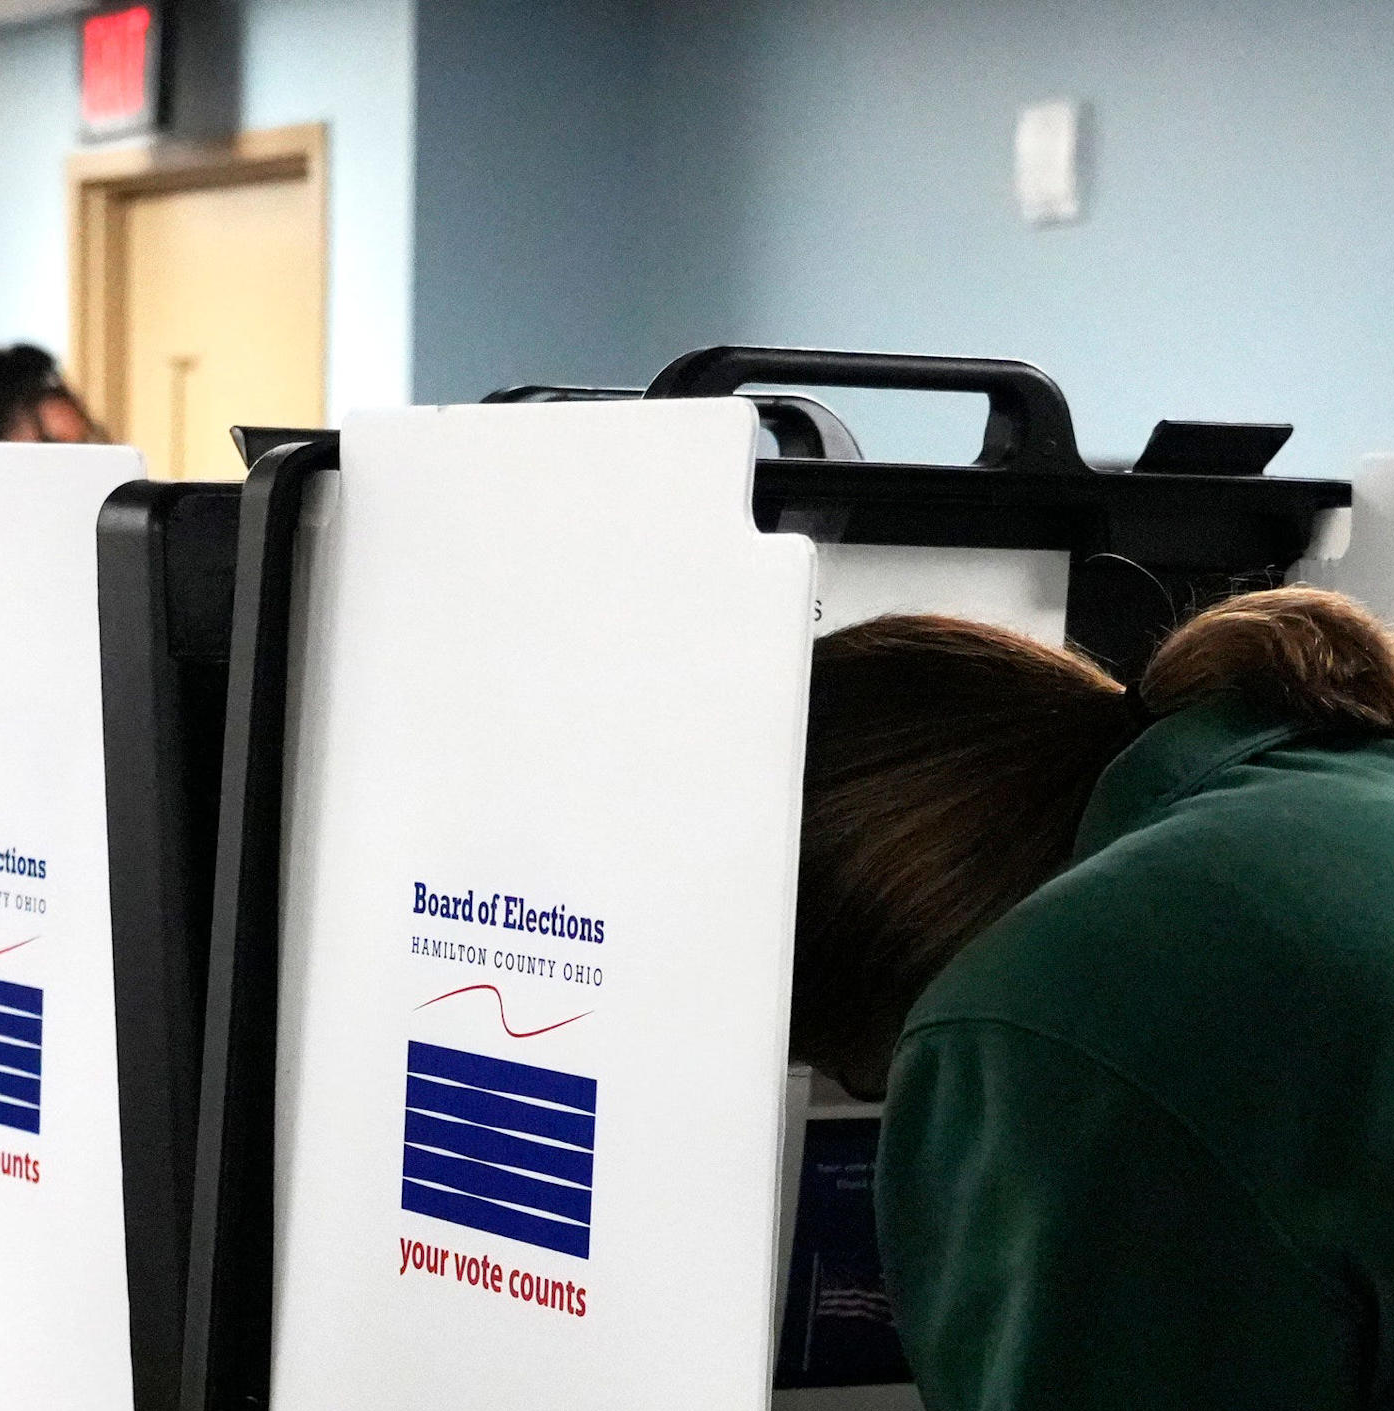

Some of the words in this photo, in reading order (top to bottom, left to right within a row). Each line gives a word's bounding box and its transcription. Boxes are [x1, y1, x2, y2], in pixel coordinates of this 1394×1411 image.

[15, 894, 47, 914] OHIO
[413, 881, 474, 924] Board
[477, 893, 500, 927] of
[503, 895, 605, 944] Elections
[411, 936, 487, 966] HAMILTON
[493, 950, 557, 979] COUNTY
[563, 962, 604, 987] OHIO
[400, 1237, 449, 1276] your
[454, 1251, 503, 1294] vote
[509, 1267, 587, 1318] counts
